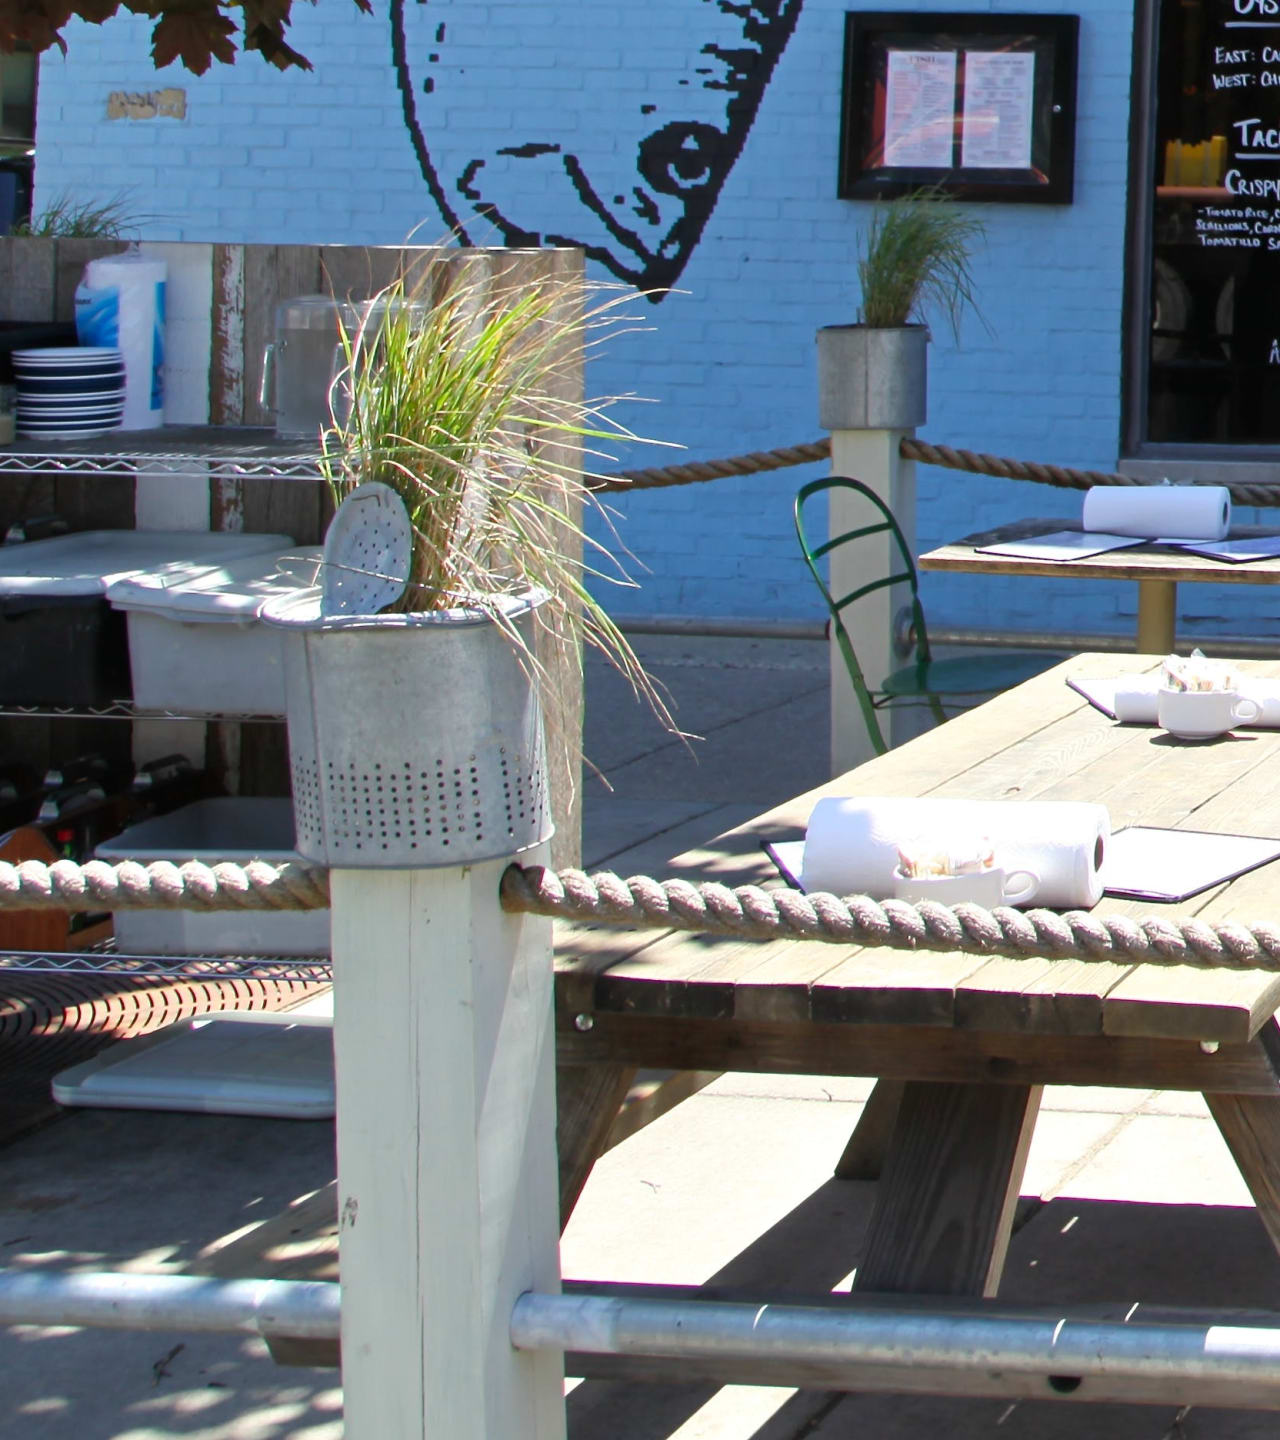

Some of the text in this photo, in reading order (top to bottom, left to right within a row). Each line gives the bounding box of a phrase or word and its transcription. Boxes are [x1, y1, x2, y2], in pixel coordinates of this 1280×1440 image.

[1215, 46, 1255, 64] EAST:
[1213, 73, 1256, 90] WEST:
[1225, 169, 1280, 201] CRISPY
